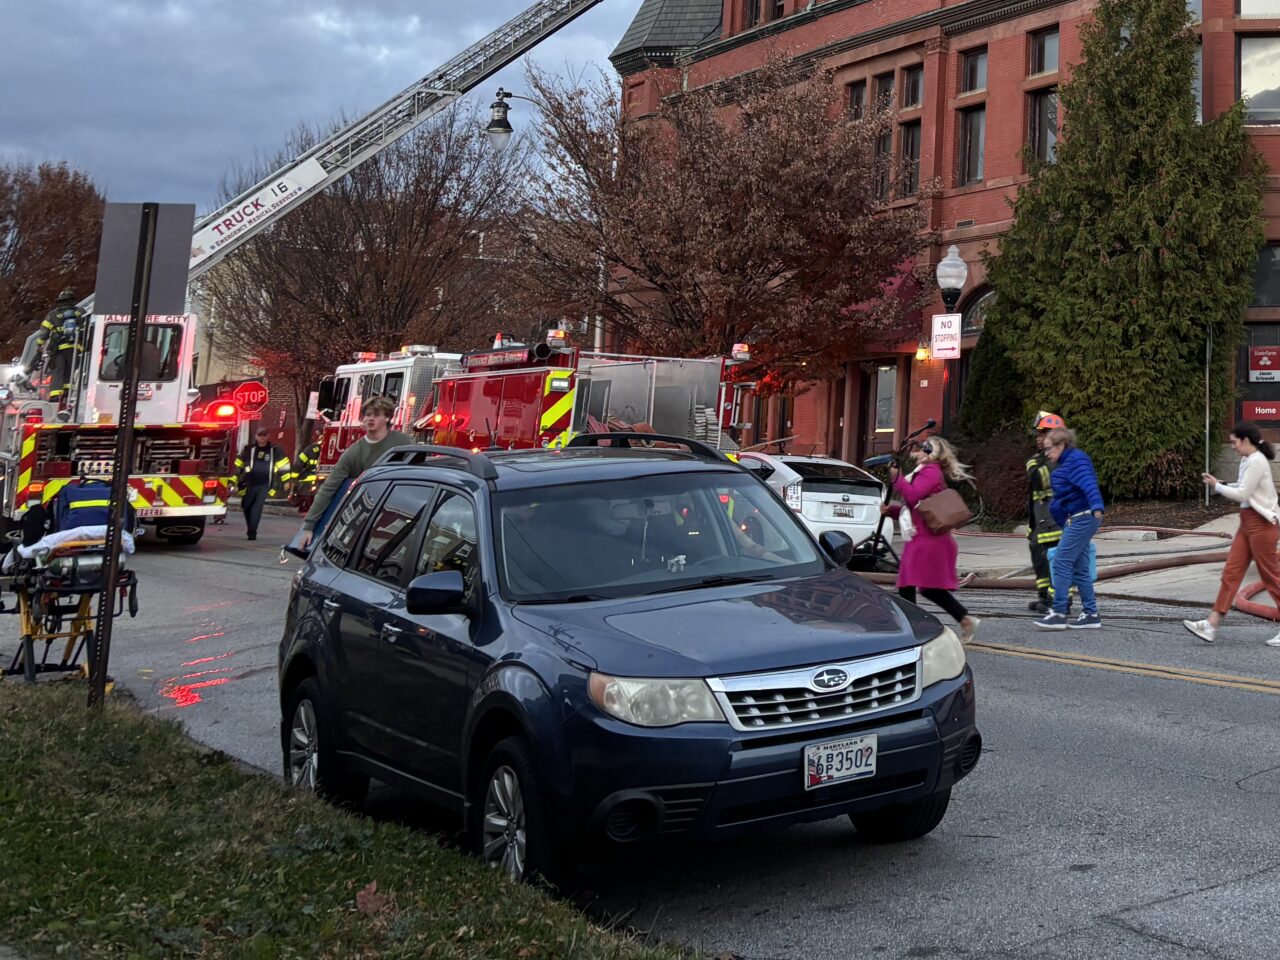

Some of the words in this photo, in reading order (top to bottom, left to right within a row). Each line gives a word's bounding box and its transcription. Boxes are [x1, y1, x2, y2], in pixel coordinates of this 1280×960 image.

[212, 197, 265, 236] TRUCK
[270, 181, 289, 198] 16
[215, 224, 248, 248] EMERGENCY
[247, 207, 272, 226] MEDICAL
[271, 189, 298, 210] SERVICES
[165, 314, 189, 323] CITY
[941, 320, 953, 329] NO
[935, 333, 958, 342] STOPPING
[236, 390, 266, 405] STOP
[1255, 406, 1277, 414] Home
[823, 740, 858, 751] MARYLAND
